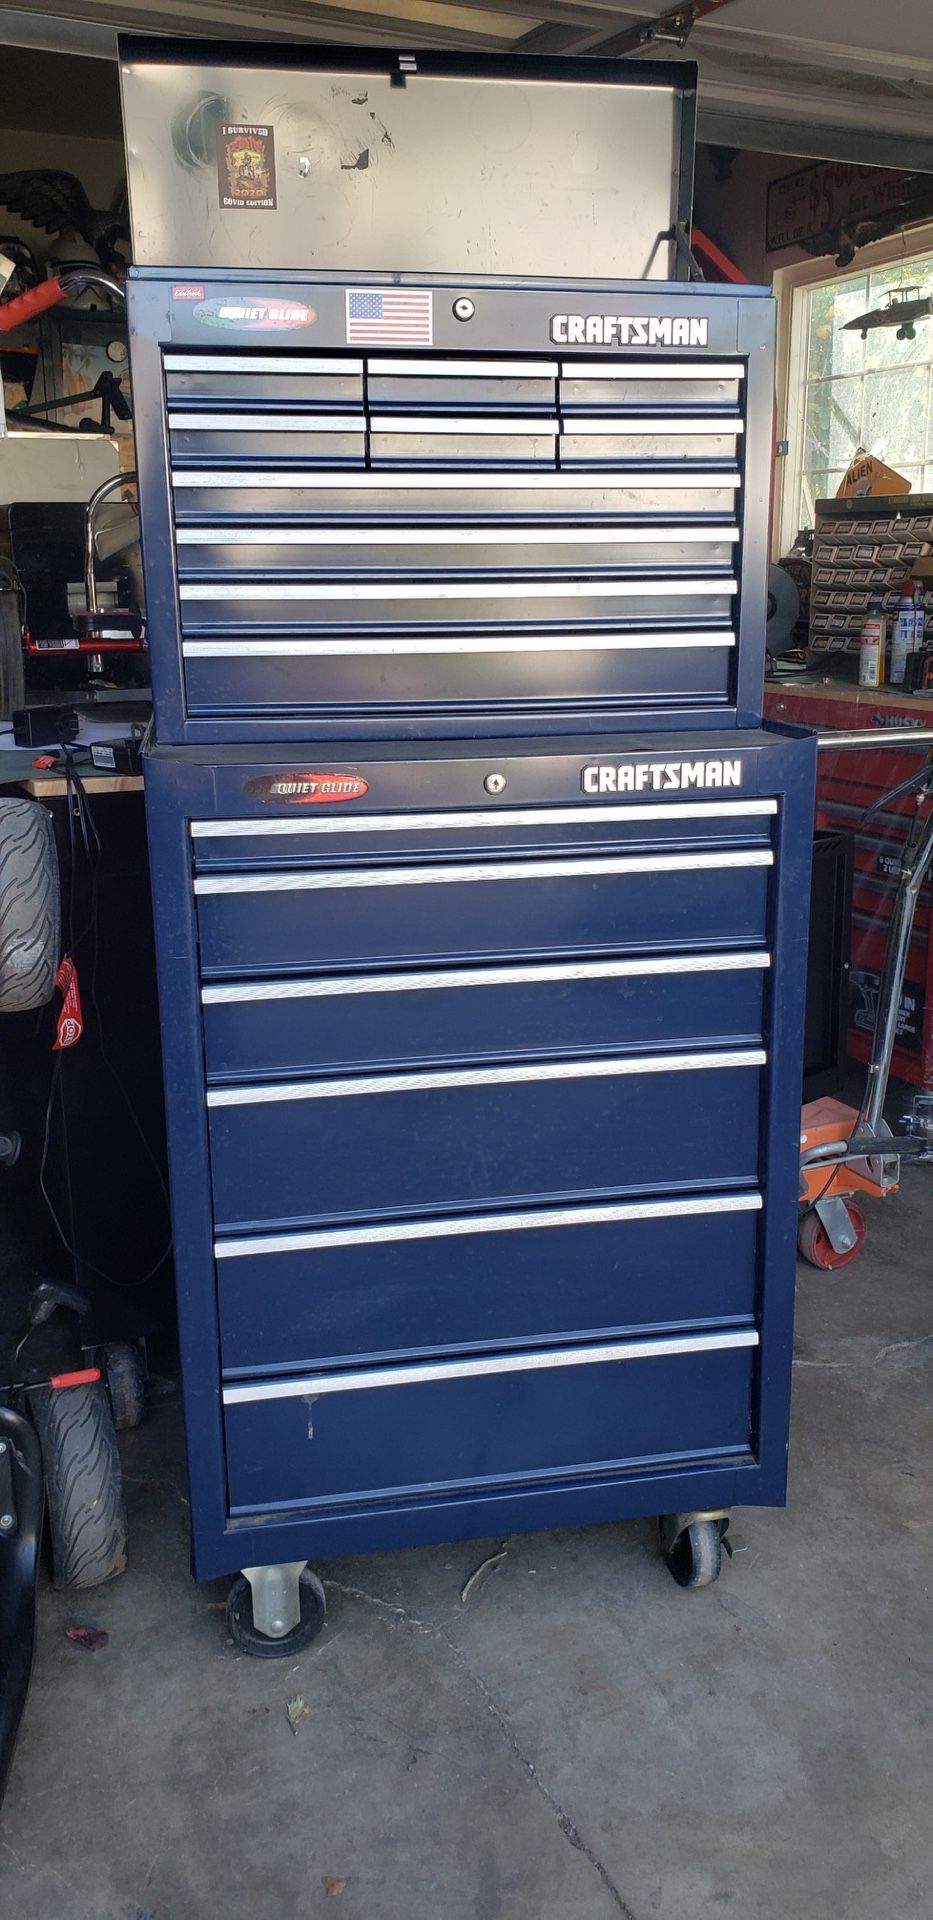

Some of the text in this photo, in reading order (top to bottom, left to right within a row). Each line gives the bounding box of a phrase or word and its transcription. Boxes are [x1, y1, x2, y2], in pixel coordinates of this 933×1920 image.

[222, 127, 269, 136] I SURVIVED
[233, 189, 264, 197] 2020
[223, 197, 274, 207] COVID EDITION
[268, 308, 309, 321] GLIDE
[551, 313, 709, 346] CRAFTSMAN
[847, 461, 873, 486] ALIEN
[582, 759, 742, 793] CRAFTSMAN
[277, 781, 361, 795] QUIET GLIDE
